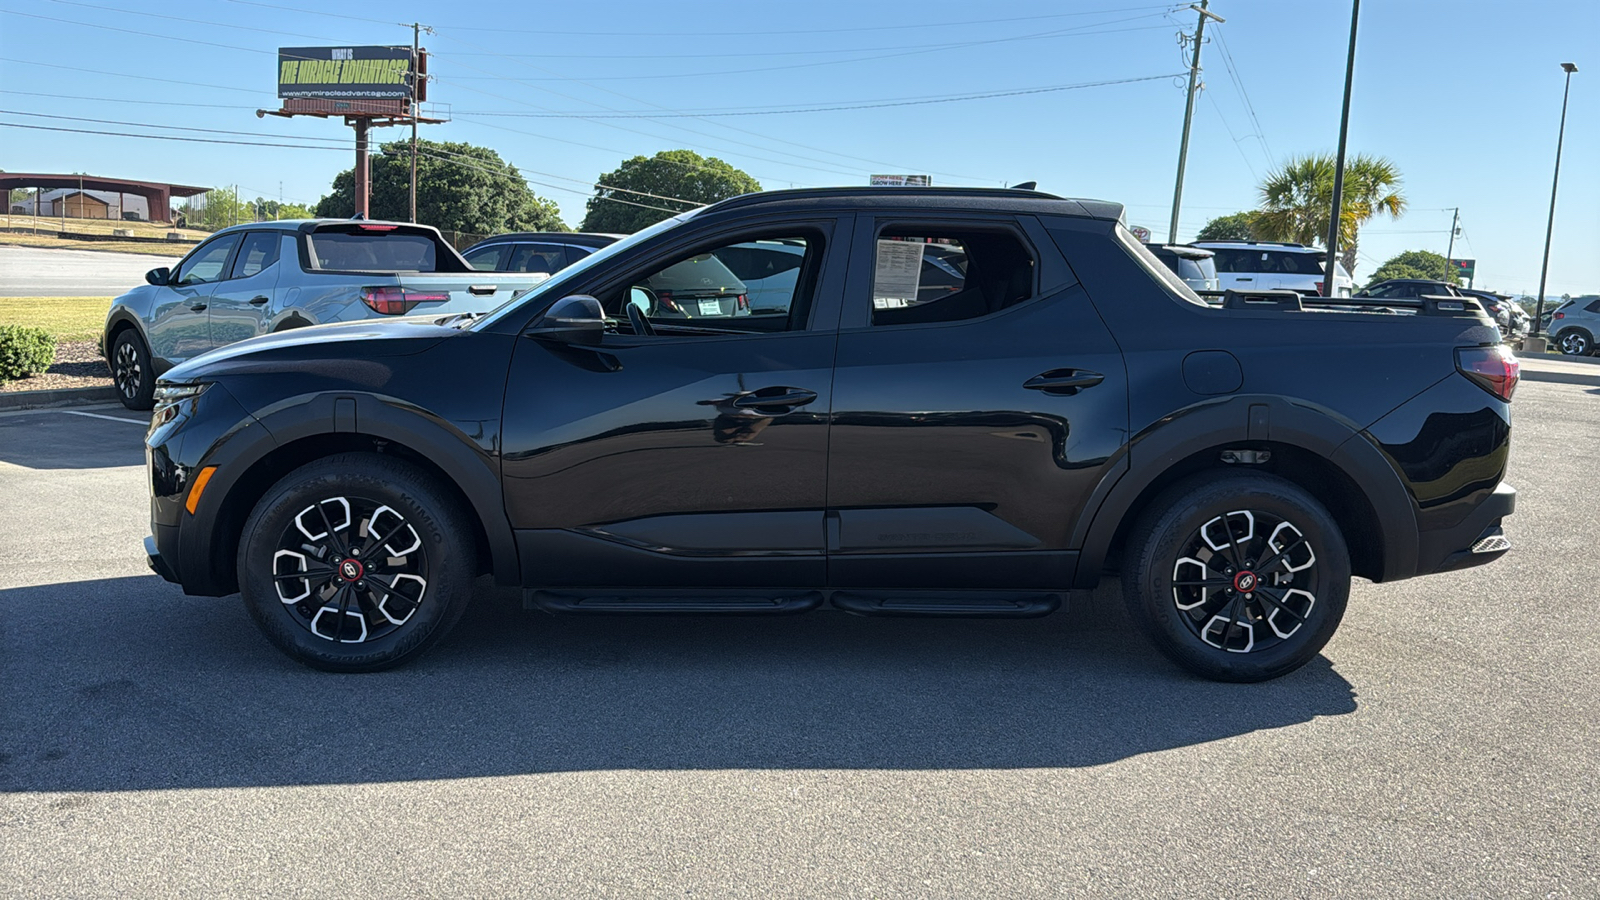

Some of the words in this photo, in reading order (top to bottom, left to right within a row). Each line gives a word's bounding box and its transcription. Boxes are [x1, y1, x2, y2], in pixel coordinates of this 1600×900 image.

[332, 48, 347, 60] WHAT
[347, 48, 354, 60] IS
[279, 60, 299, 84] THE
[297, 59, 342, 84] MIRACLE
[339, 59, 409, 84] ADVANTAGE?
